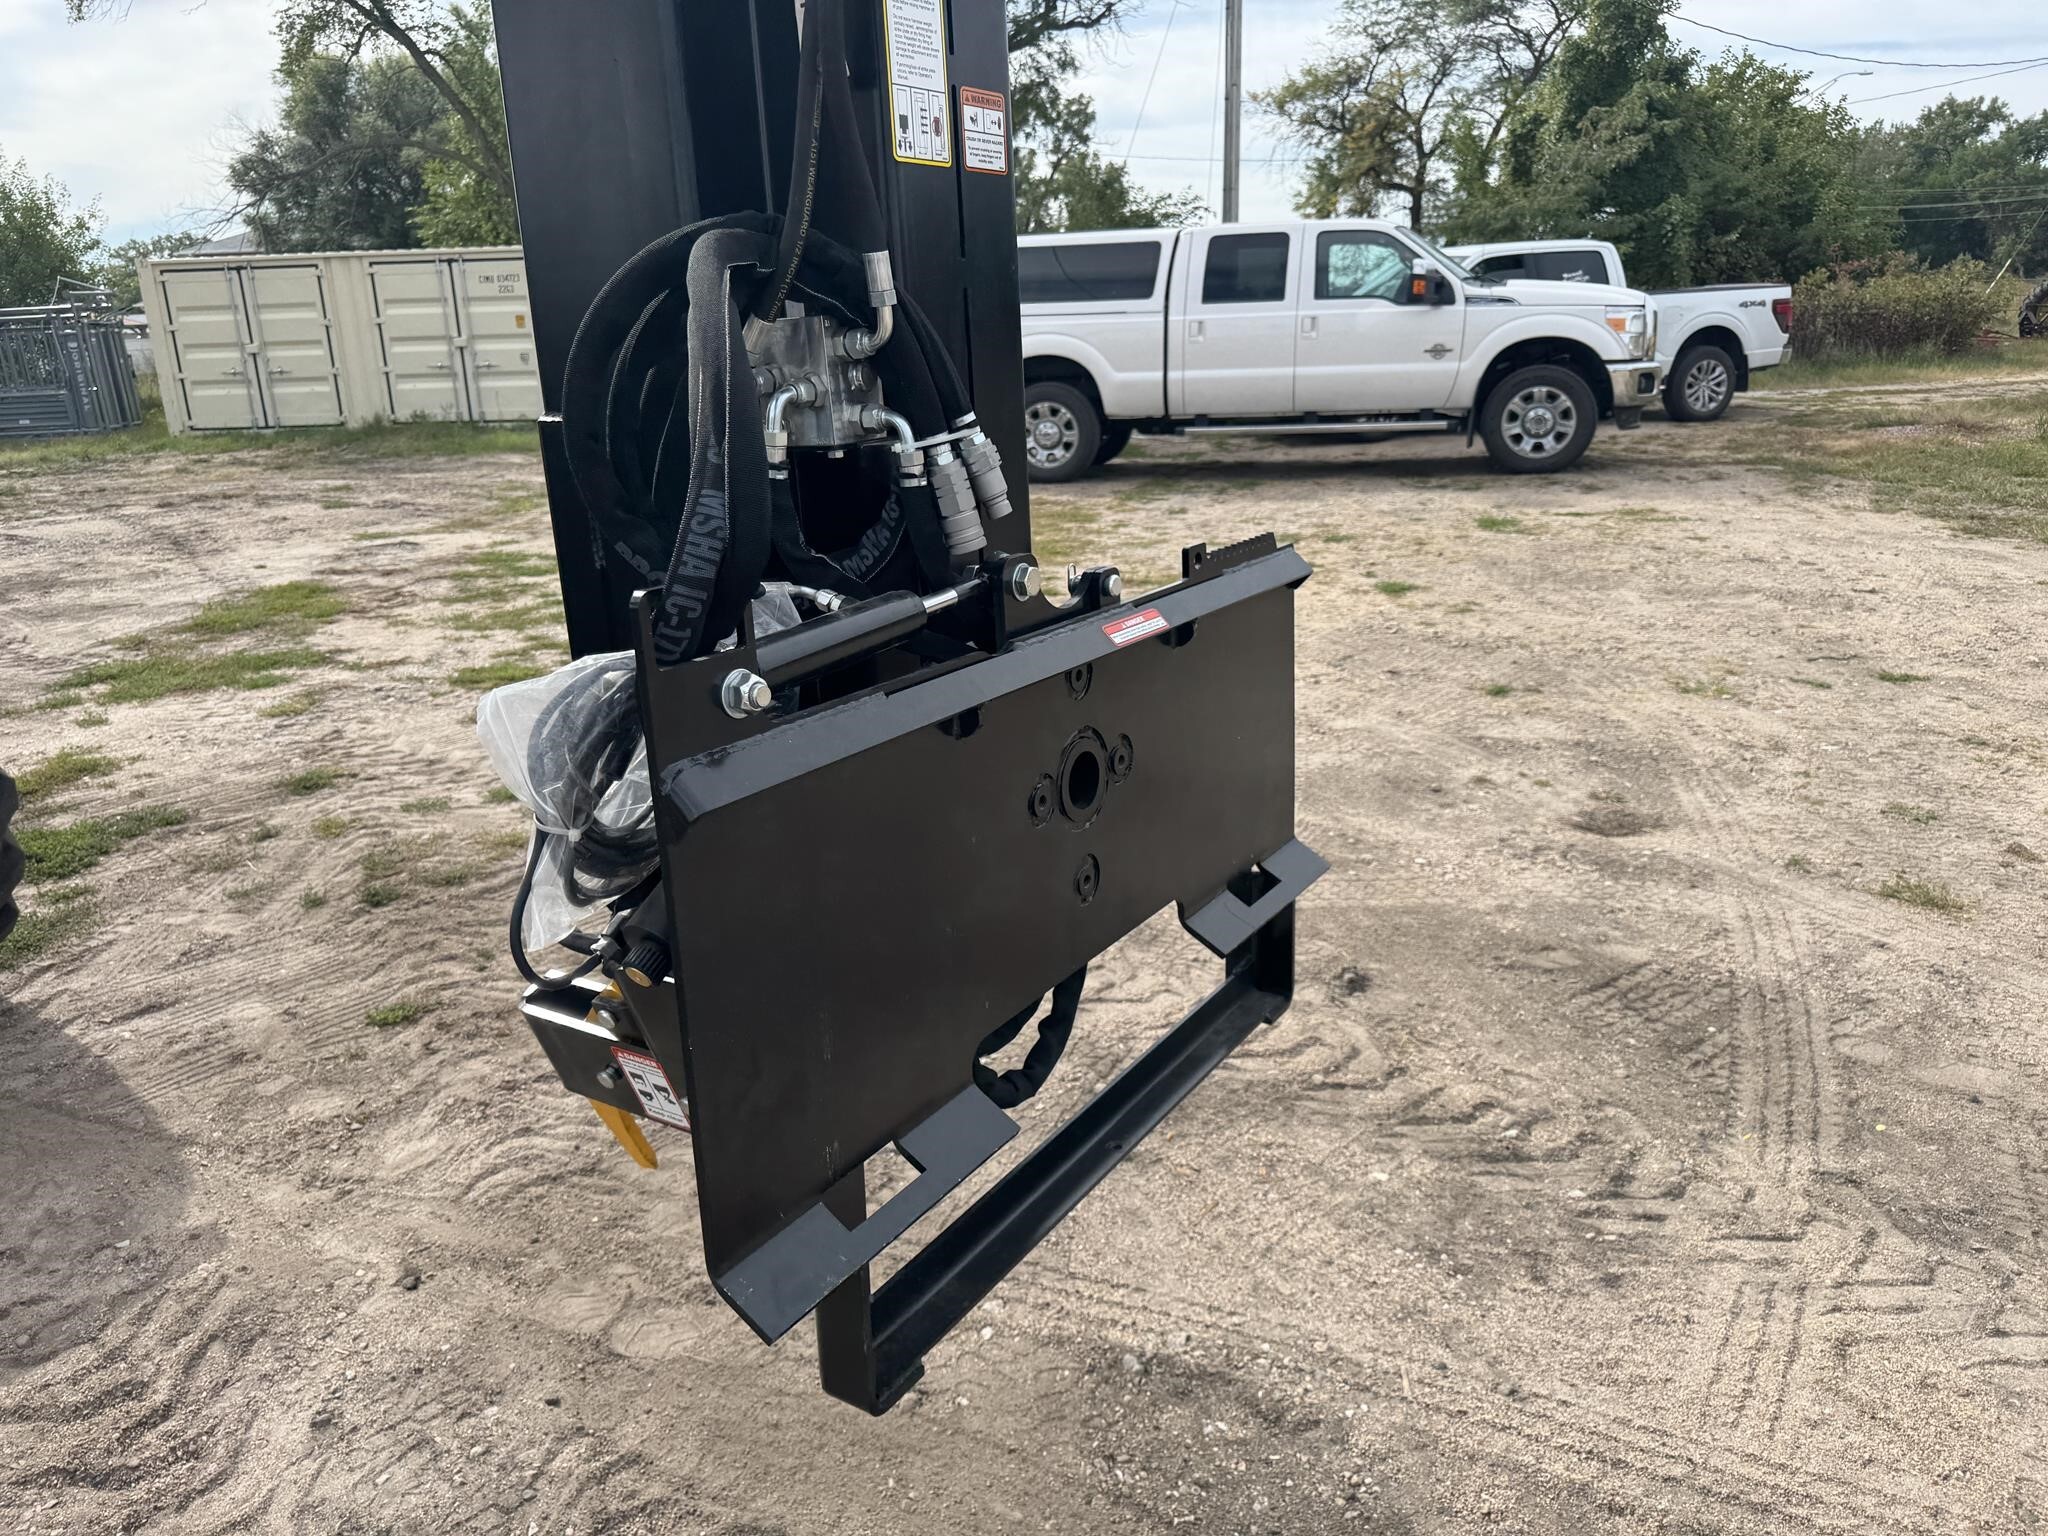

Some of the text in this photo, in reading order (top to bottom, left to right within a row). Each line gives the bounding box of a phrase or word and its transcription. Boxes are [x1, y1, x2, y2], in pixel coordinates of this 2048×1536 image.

[971, 94, 1002, 109] WARNING
[799, 167, 817, 237] WEARGUARD
[784, 256, 798, 282] INCH
[679, 489, 727, 579] MSHA
[624, 1053, 658, 1068] DANGER
